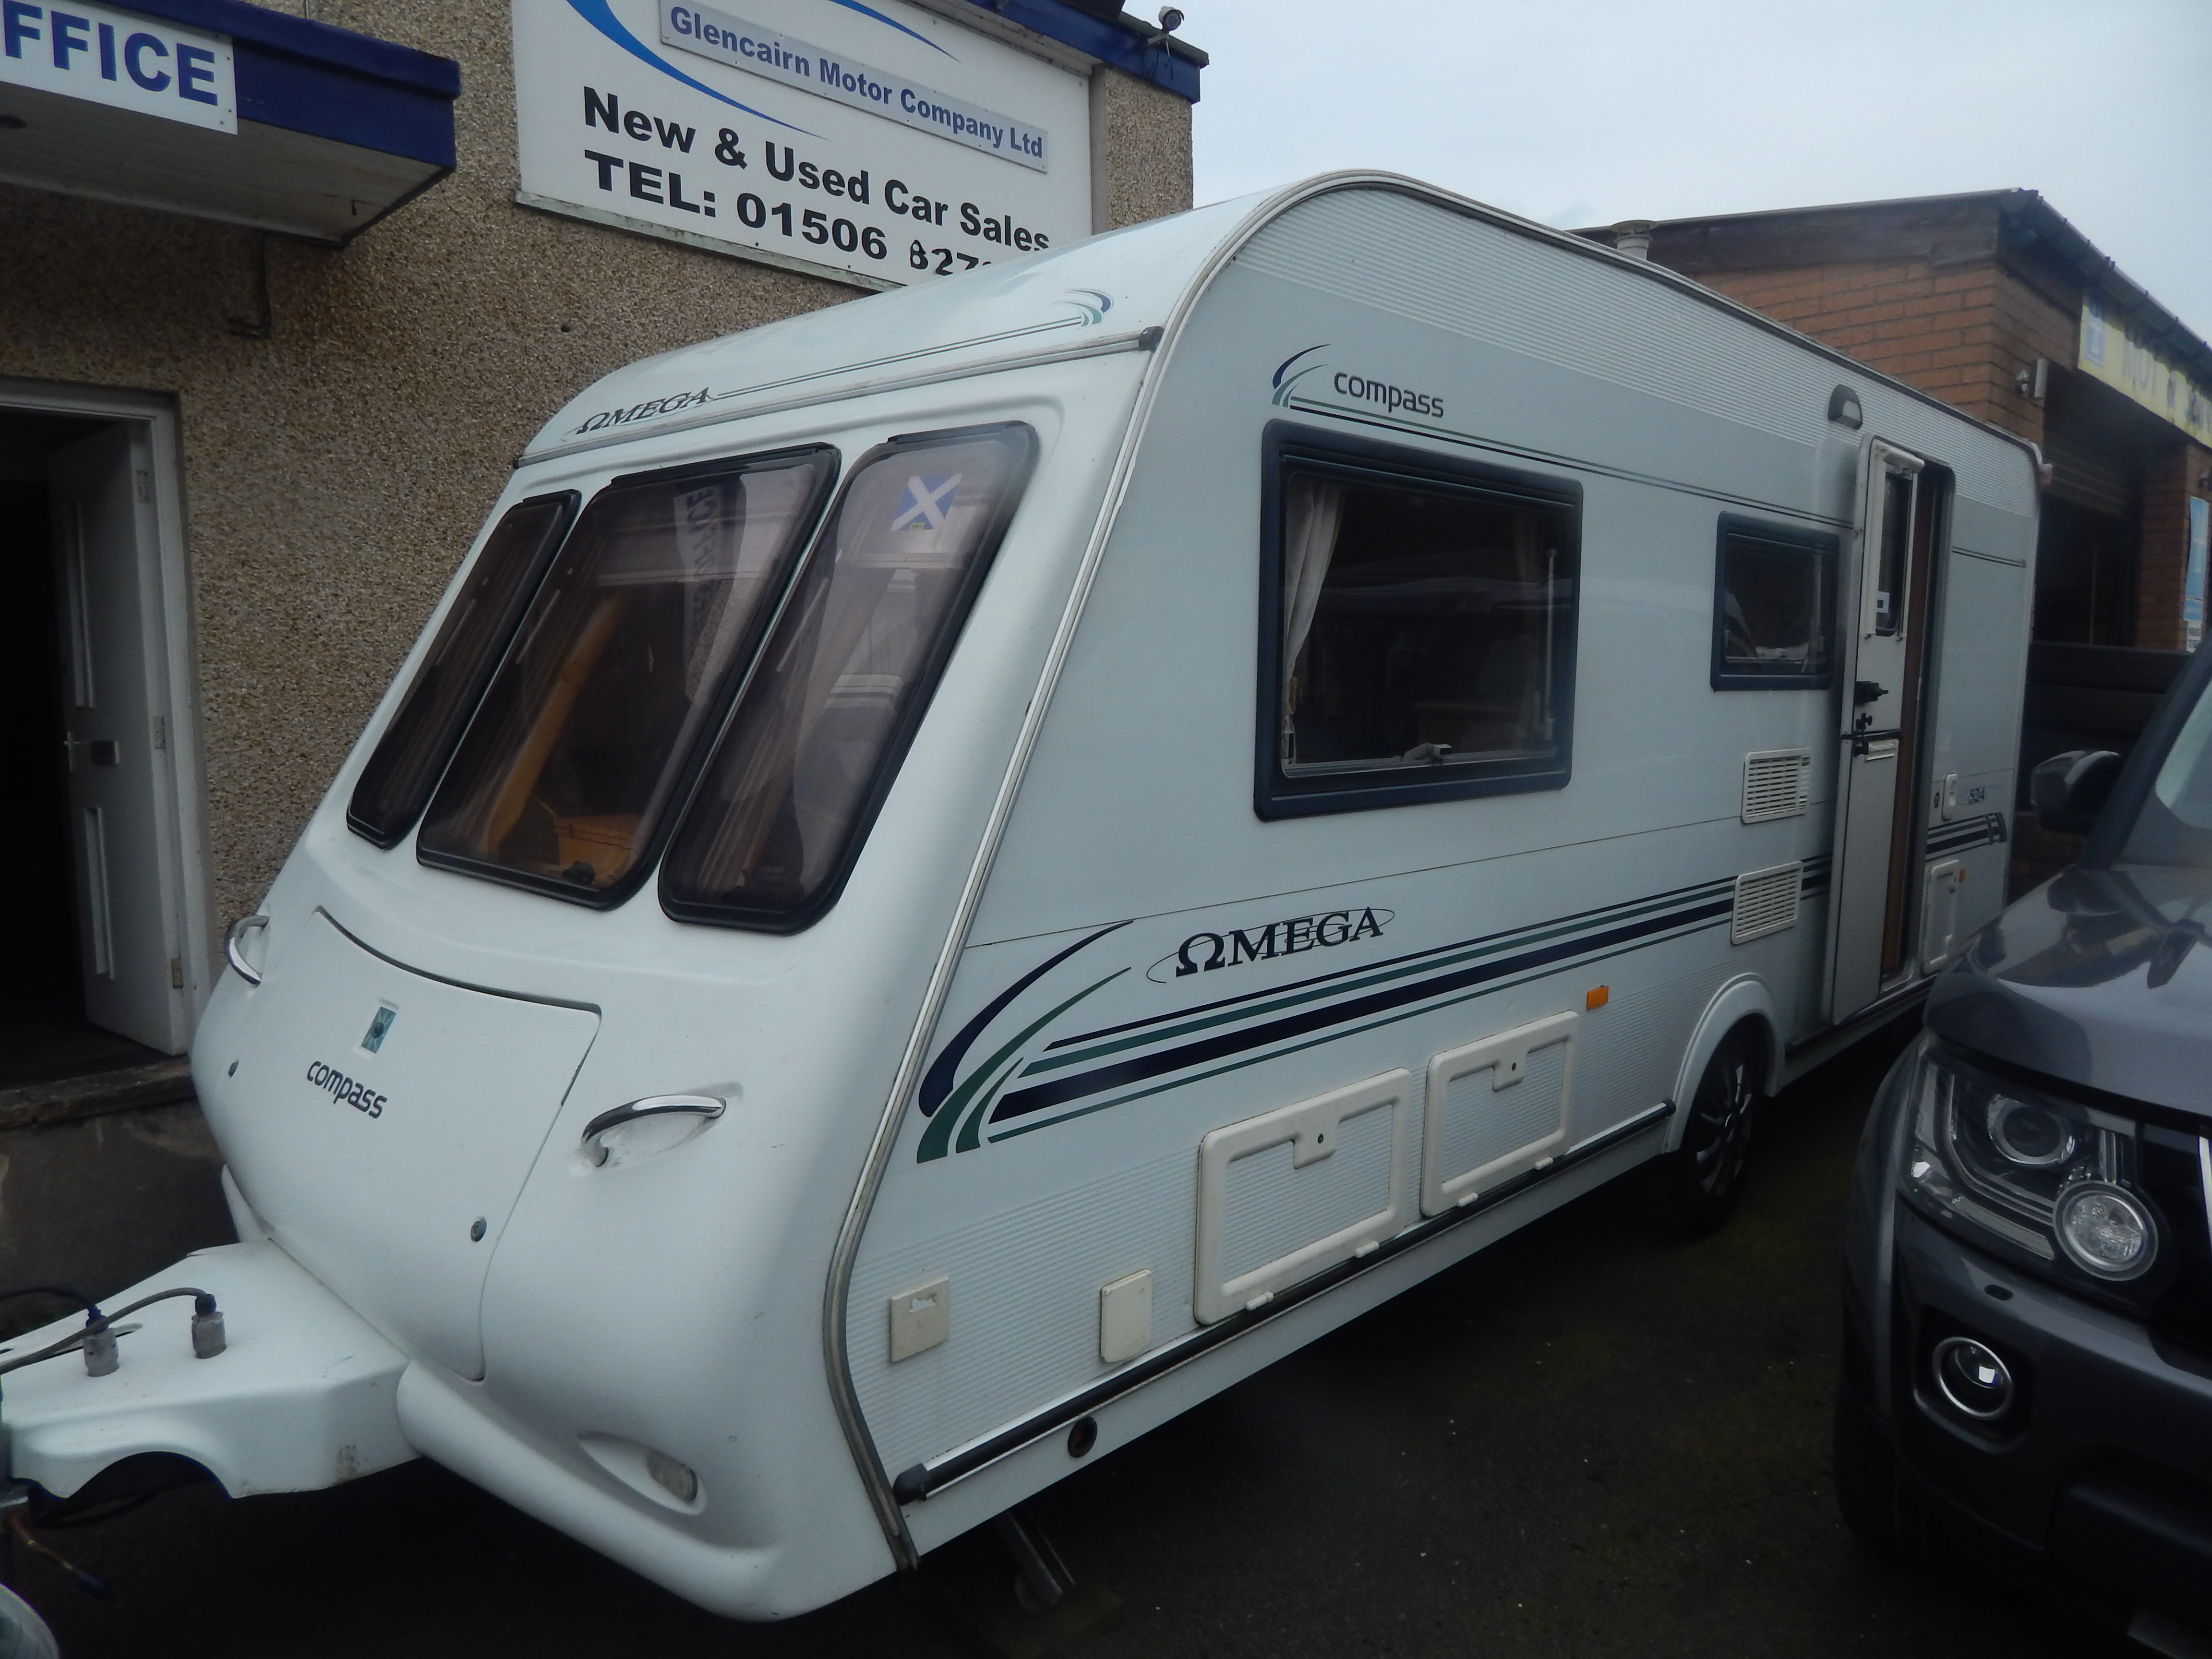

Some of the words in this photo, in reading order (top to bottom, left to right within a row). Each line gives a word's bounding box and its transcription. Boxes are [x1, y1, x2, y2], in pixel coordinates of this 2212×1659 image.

[672, 6, 810, 76] Glencairn
[819, 58, 892, 105] Motor
[901, 89, 1003, 149] Company
[1010, 127, 1042, 158] Ltd
[584, 85, 696, 153] New
[715, 128, 747, 169] &
[765, 141, 869, 205] Used
[884, 180, 949, 227] Car
[960, 203, 1049, 252] Sales
[584, 149, 716, 217] TEL:
[737, 193, 887, 260] 01506
[910, 240, 992, 276] 827
[1334, 372, 1444, 418] compass
[307, 1060, 388, 1119] compass
